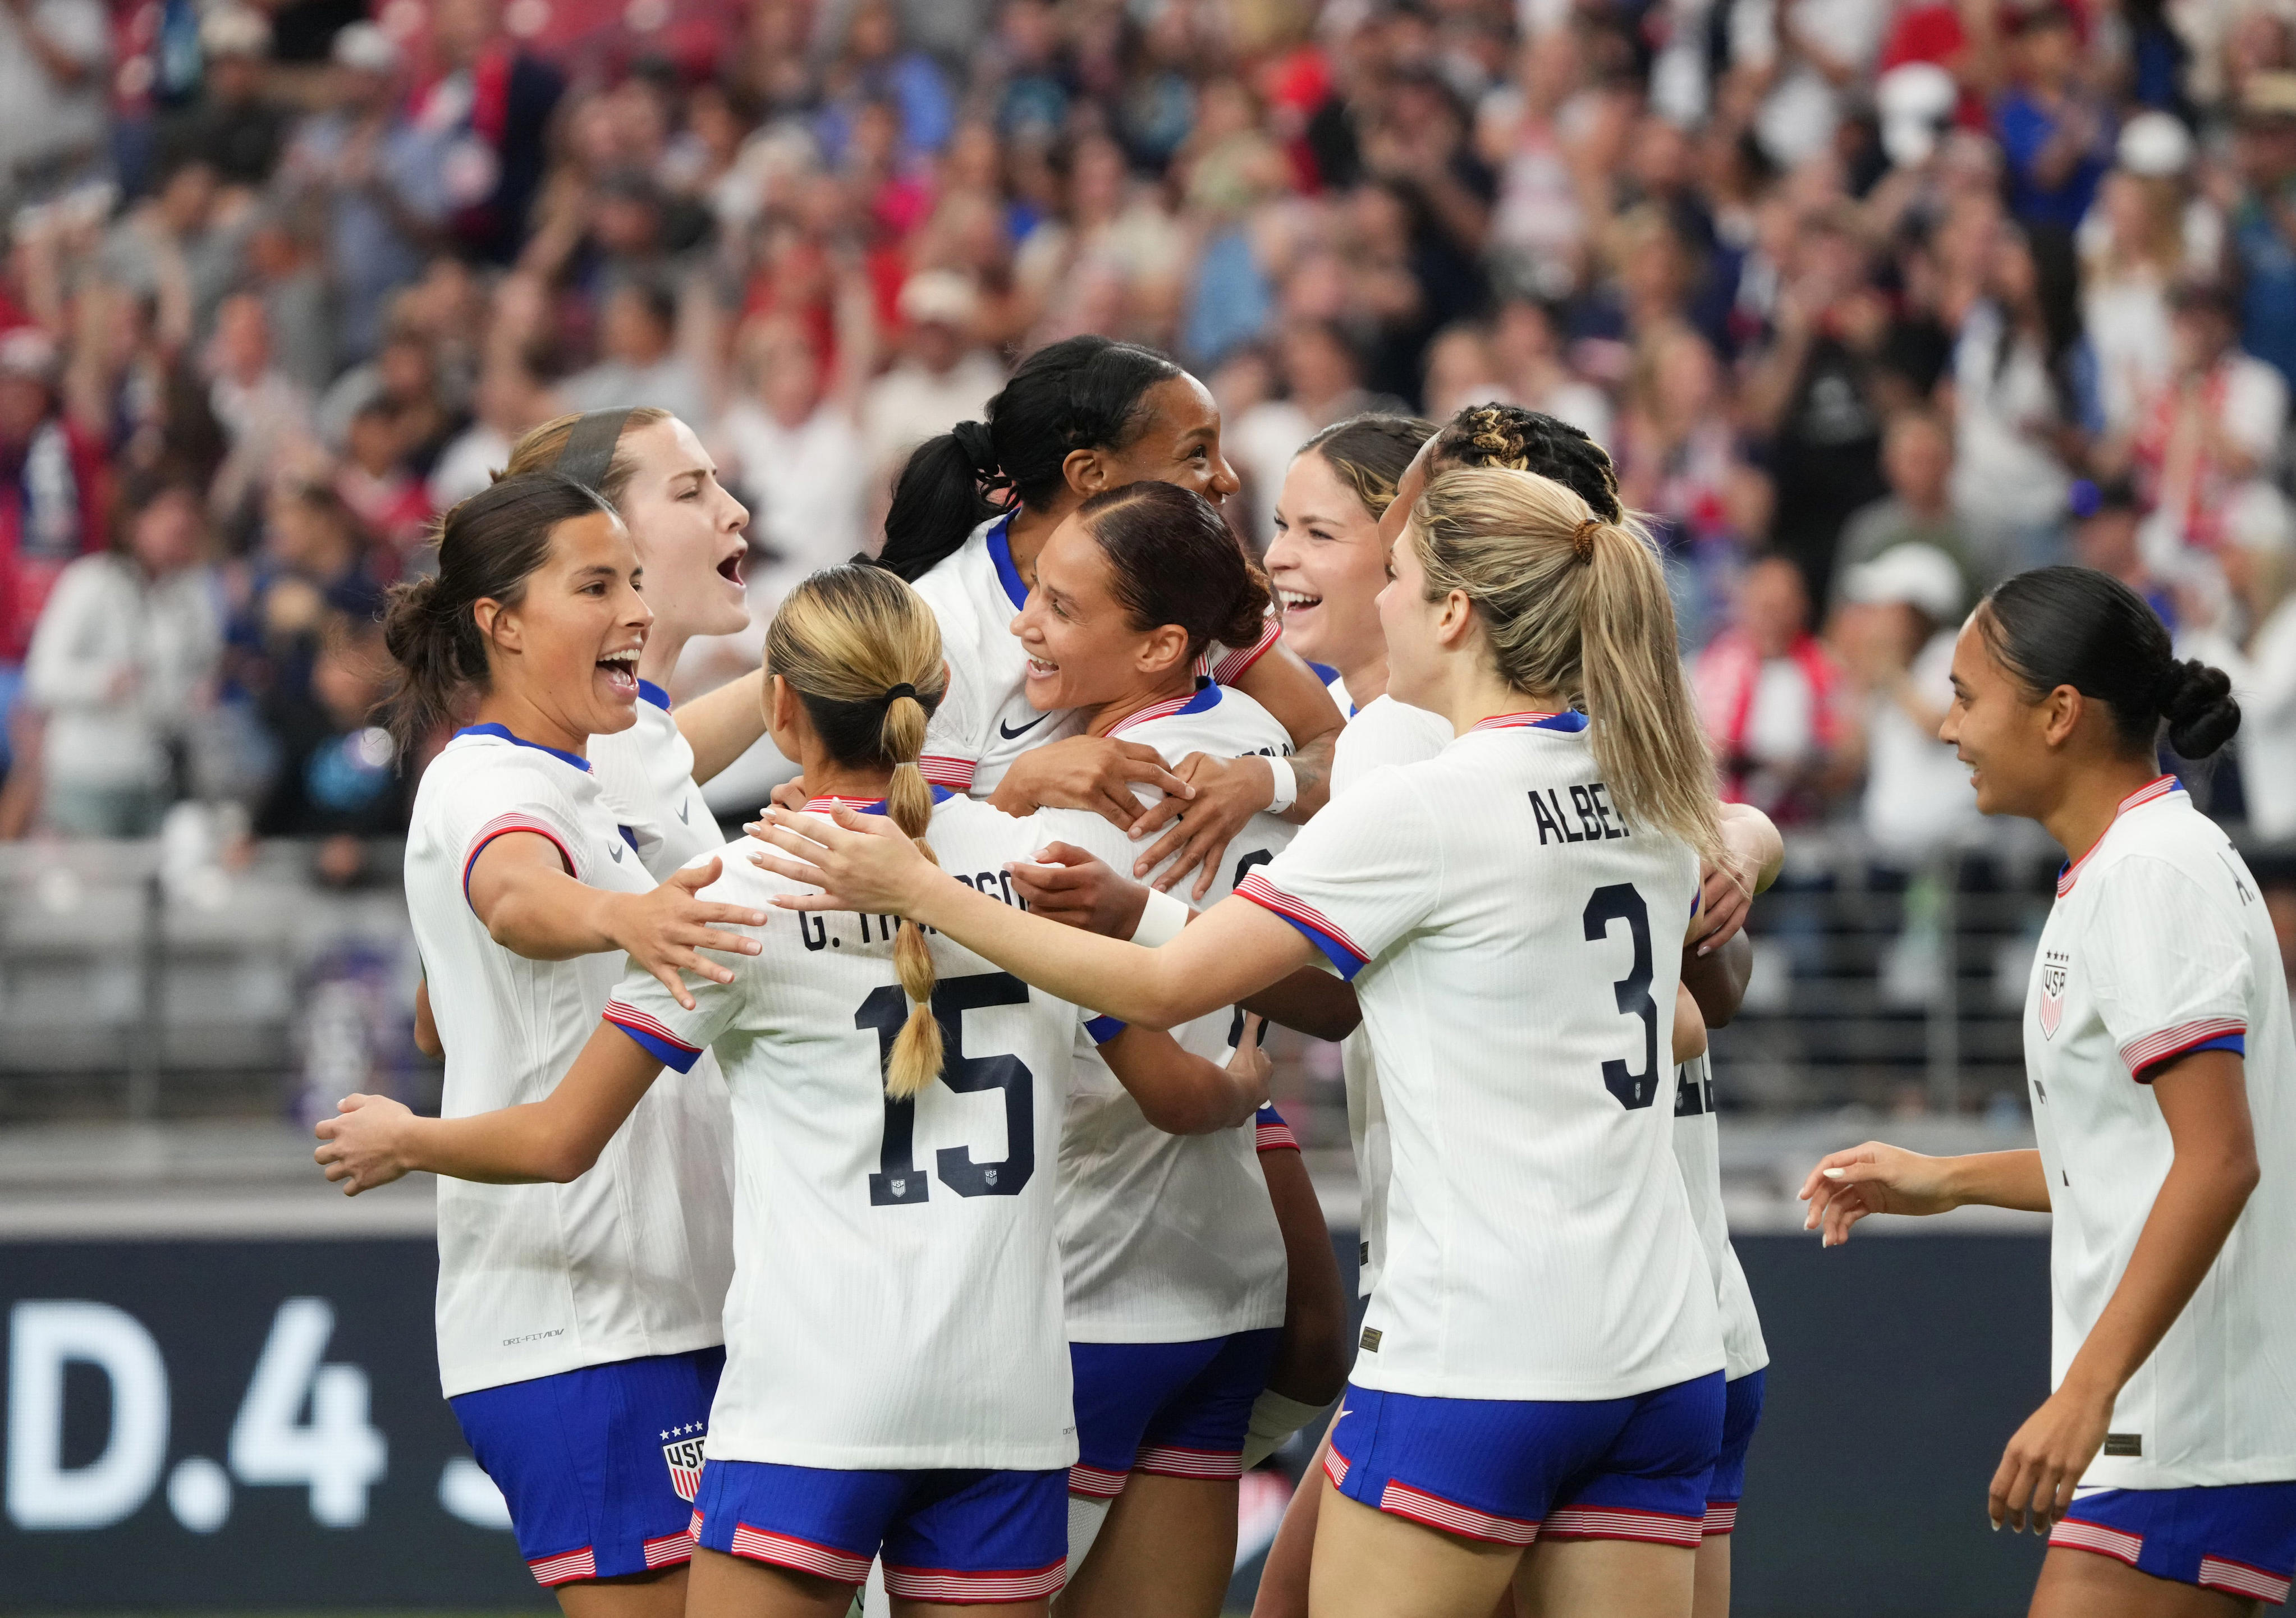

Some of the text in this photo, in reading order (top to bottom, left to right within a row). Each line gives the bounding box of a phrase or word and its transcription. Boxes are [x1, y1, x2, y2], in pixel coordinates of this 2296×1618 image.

[1528, 782, 1630, 845] ALBE
[854, 971, 1035, 1206] 15
[1583, 882, 1659, 1111] 3
[2045, 969, 2066, 997] USA
[4, 1295, 389, 1533] D.4
